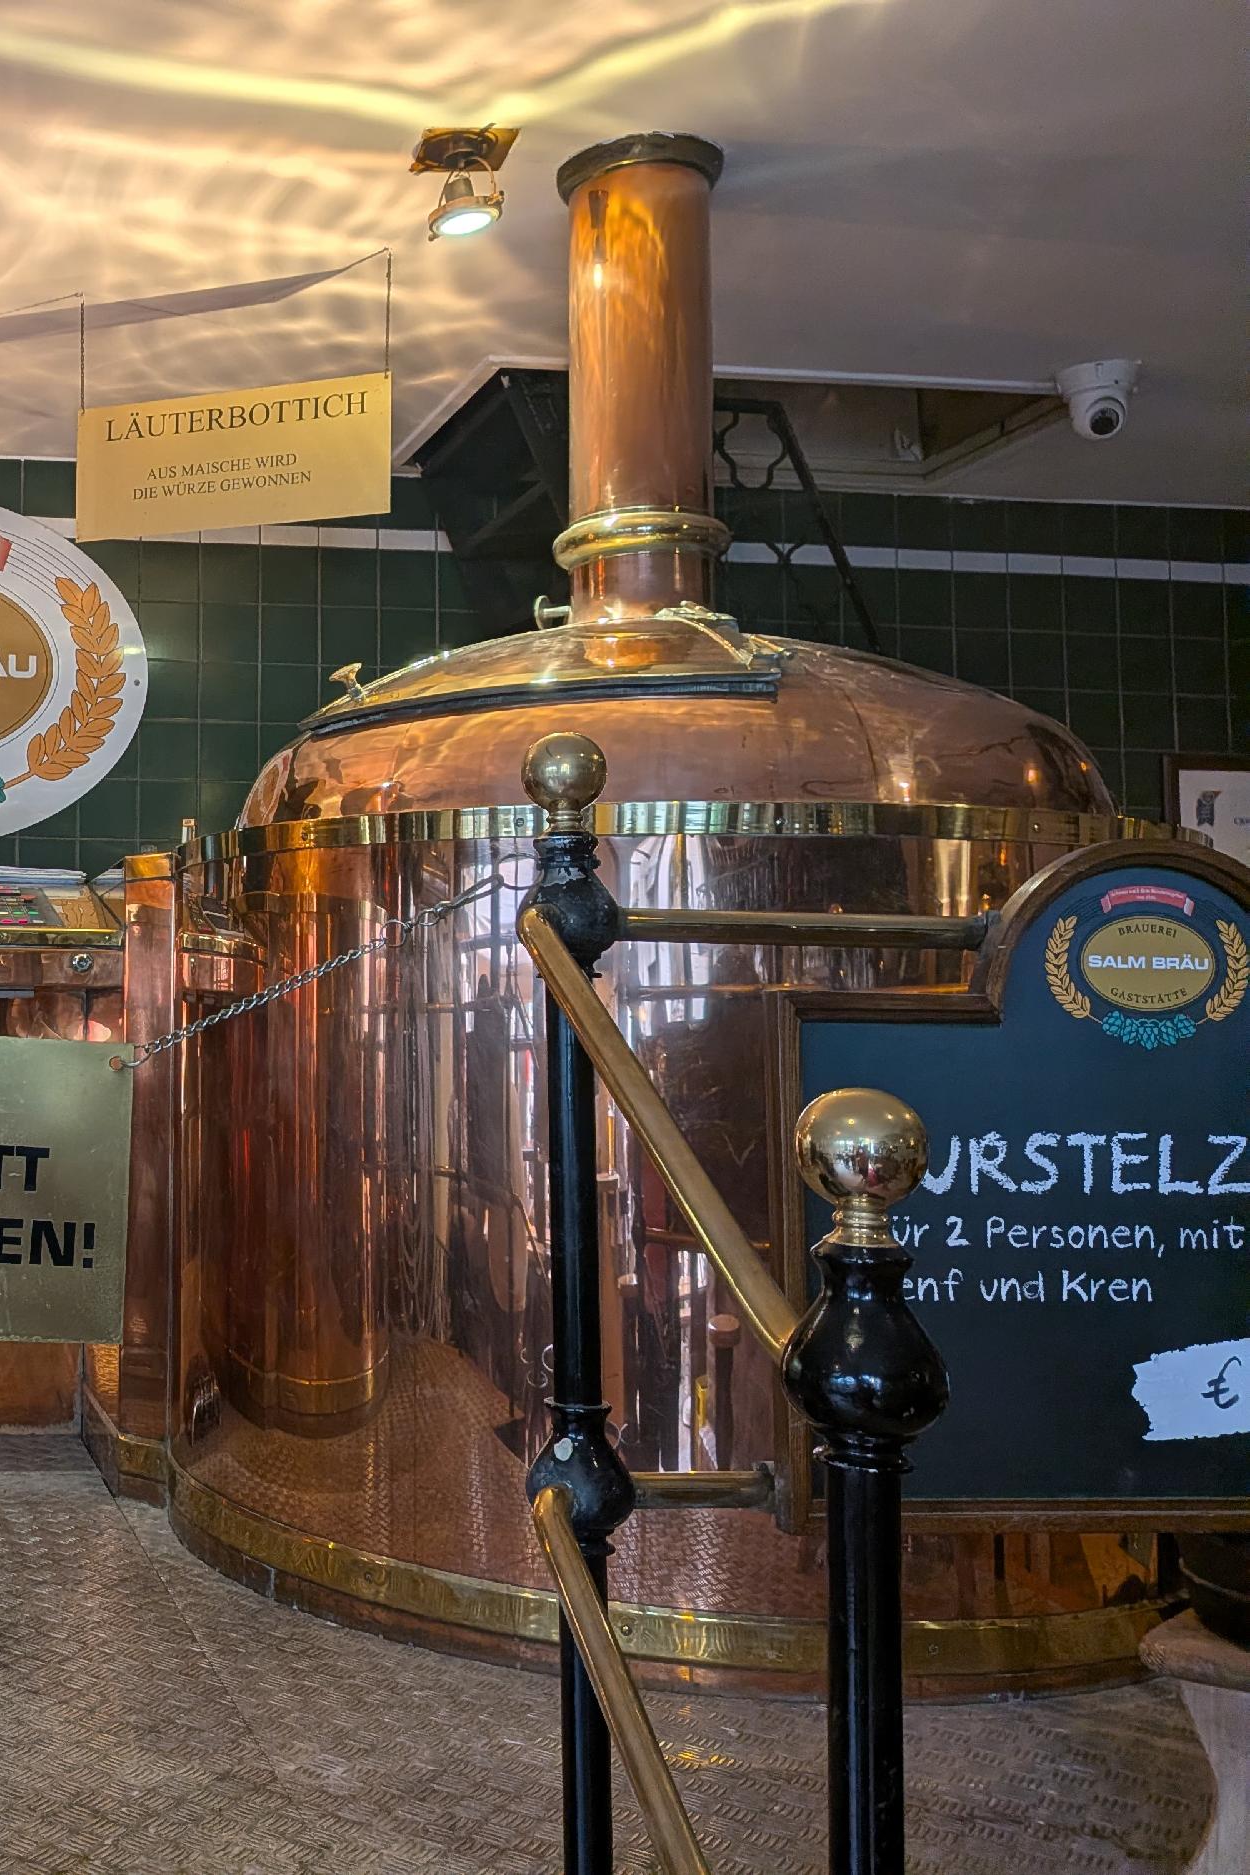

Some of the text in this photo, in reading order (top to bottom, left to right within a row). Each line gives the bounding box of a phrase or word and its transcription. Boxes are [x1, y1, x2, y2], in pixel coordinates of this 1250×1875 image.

[106, 391, 369, 442] LÄUTERBOTTICH
[147, 453, 297, 481] AUS MAISCHE WIRD
[133, 471, 312, 500] DIE WÜRZE GEWONNEN
[1118, 923, 1178, 939] BRAUEREI
[1088, 953, 1210, 971] SALM BRÄU
[919, 1131, 1250, 1195] URSTELZ
[891, 1215, 1245, 1258] ür 2 Personen, mit
[902, 1268, 1154, 1303] enf und Kren
